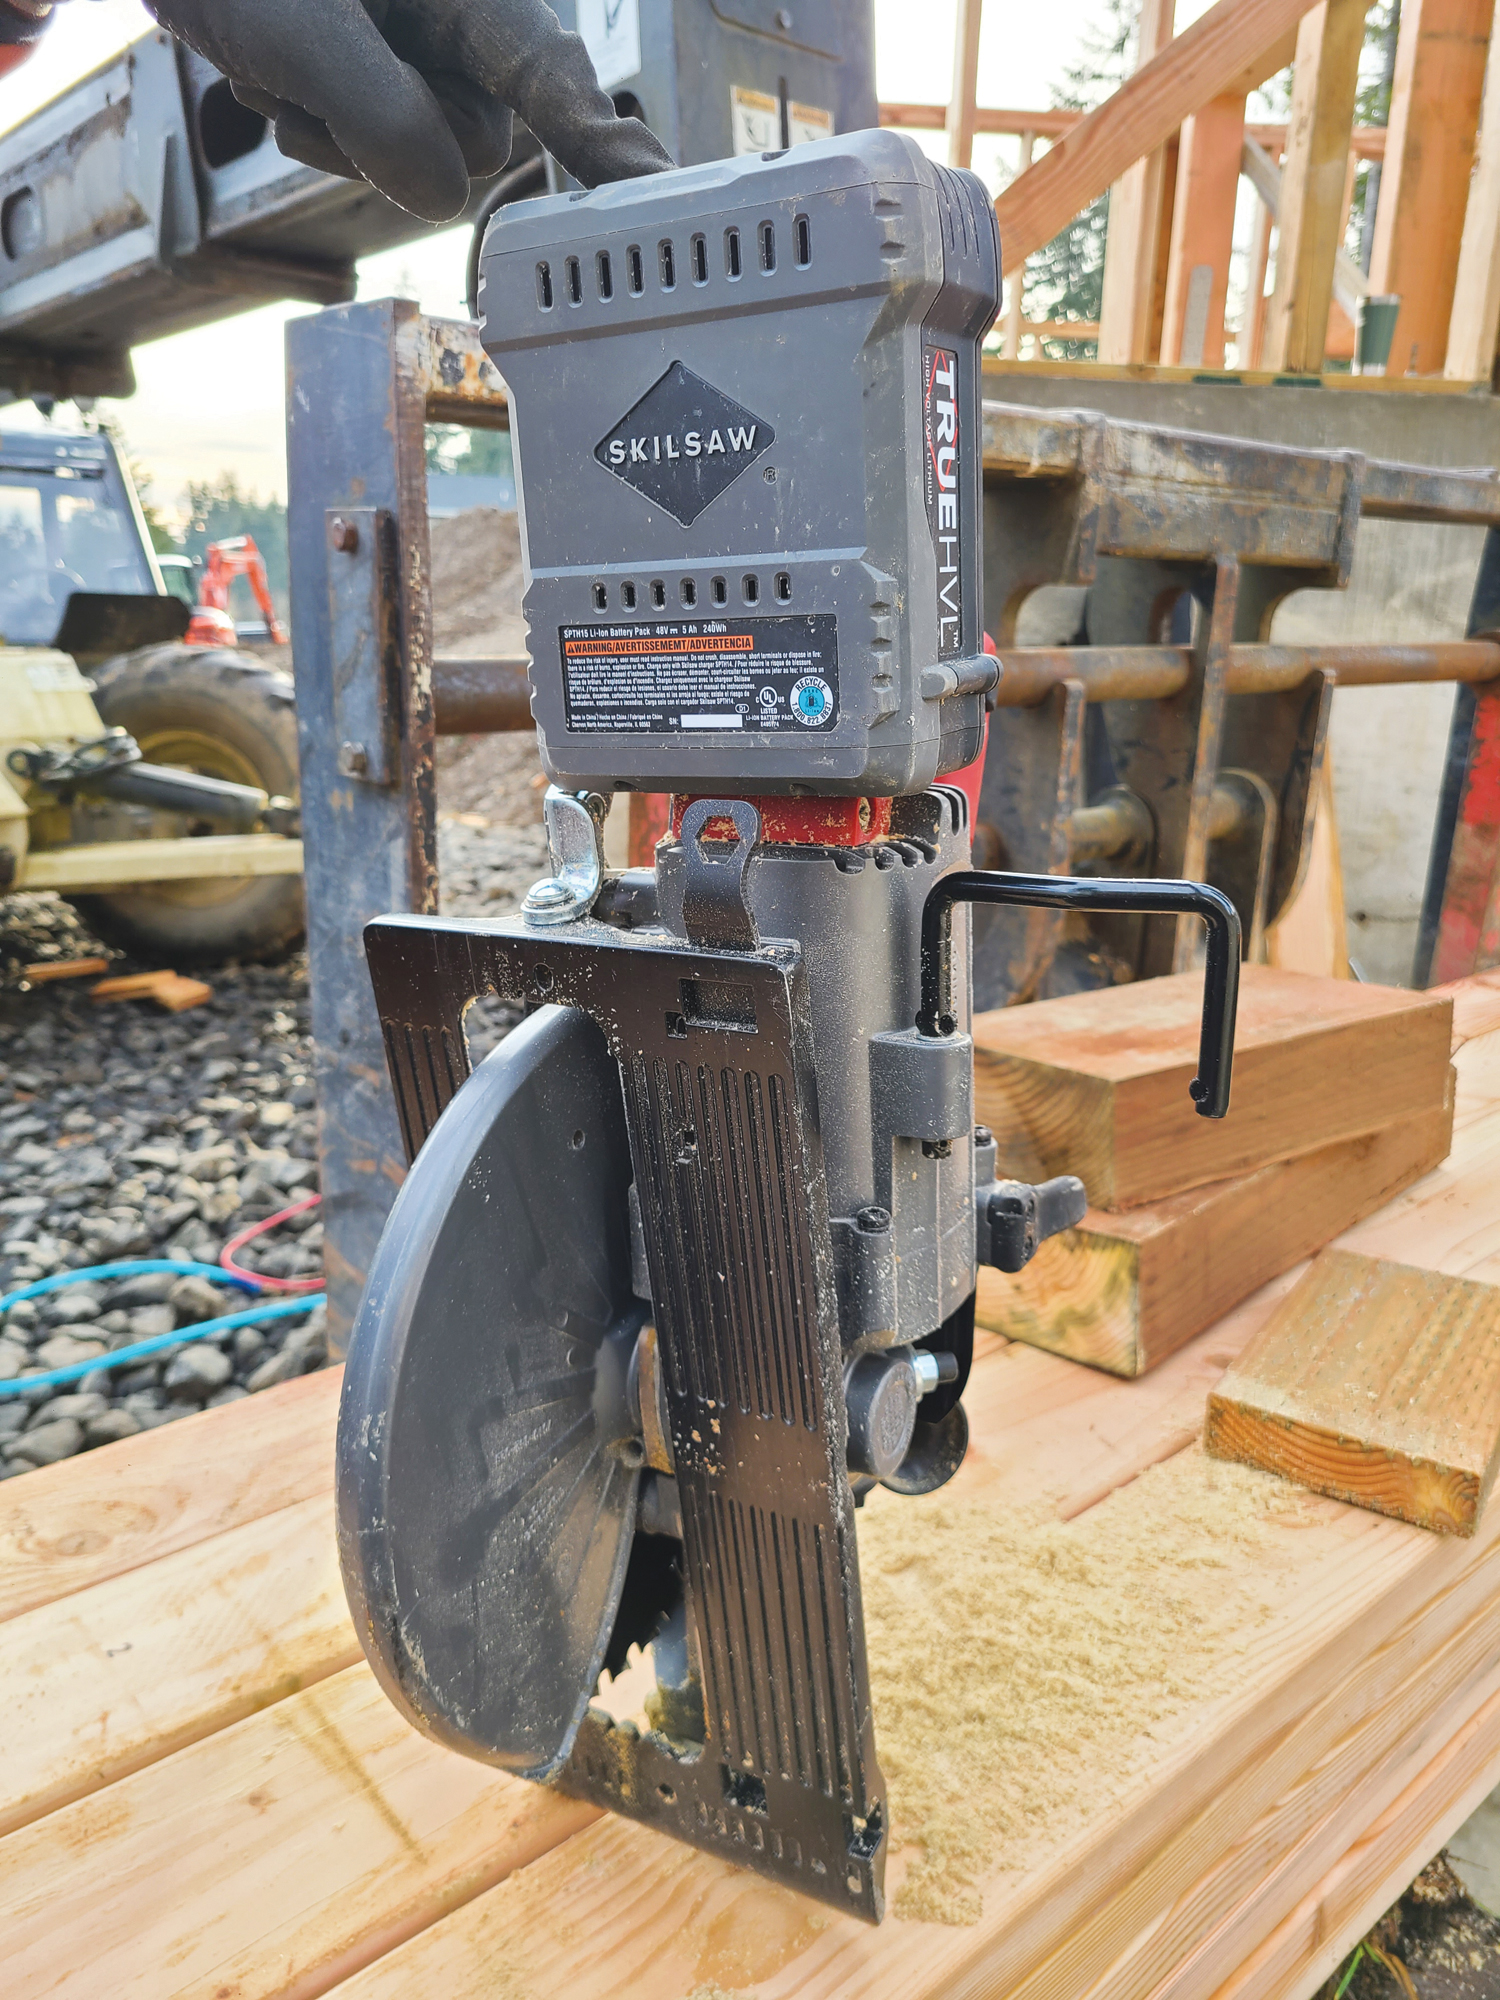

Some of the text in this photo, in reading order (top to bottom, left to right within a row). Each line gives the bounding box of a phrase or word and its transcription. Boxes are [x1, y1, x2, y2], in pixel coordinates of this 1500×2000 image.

[609, 424, 757, 464] SKILSAW
[563, 623, 726, 638] SPTH15 Li-Ion Battery Pack 48V 5 Ah 240Wh
[795, 677, 827, 692] RECYCLE
[763, 691, 773, 703] UL
[792, 701, 832, 724] 1.800.822.8837
[668, 717, 678, 725] SN:
